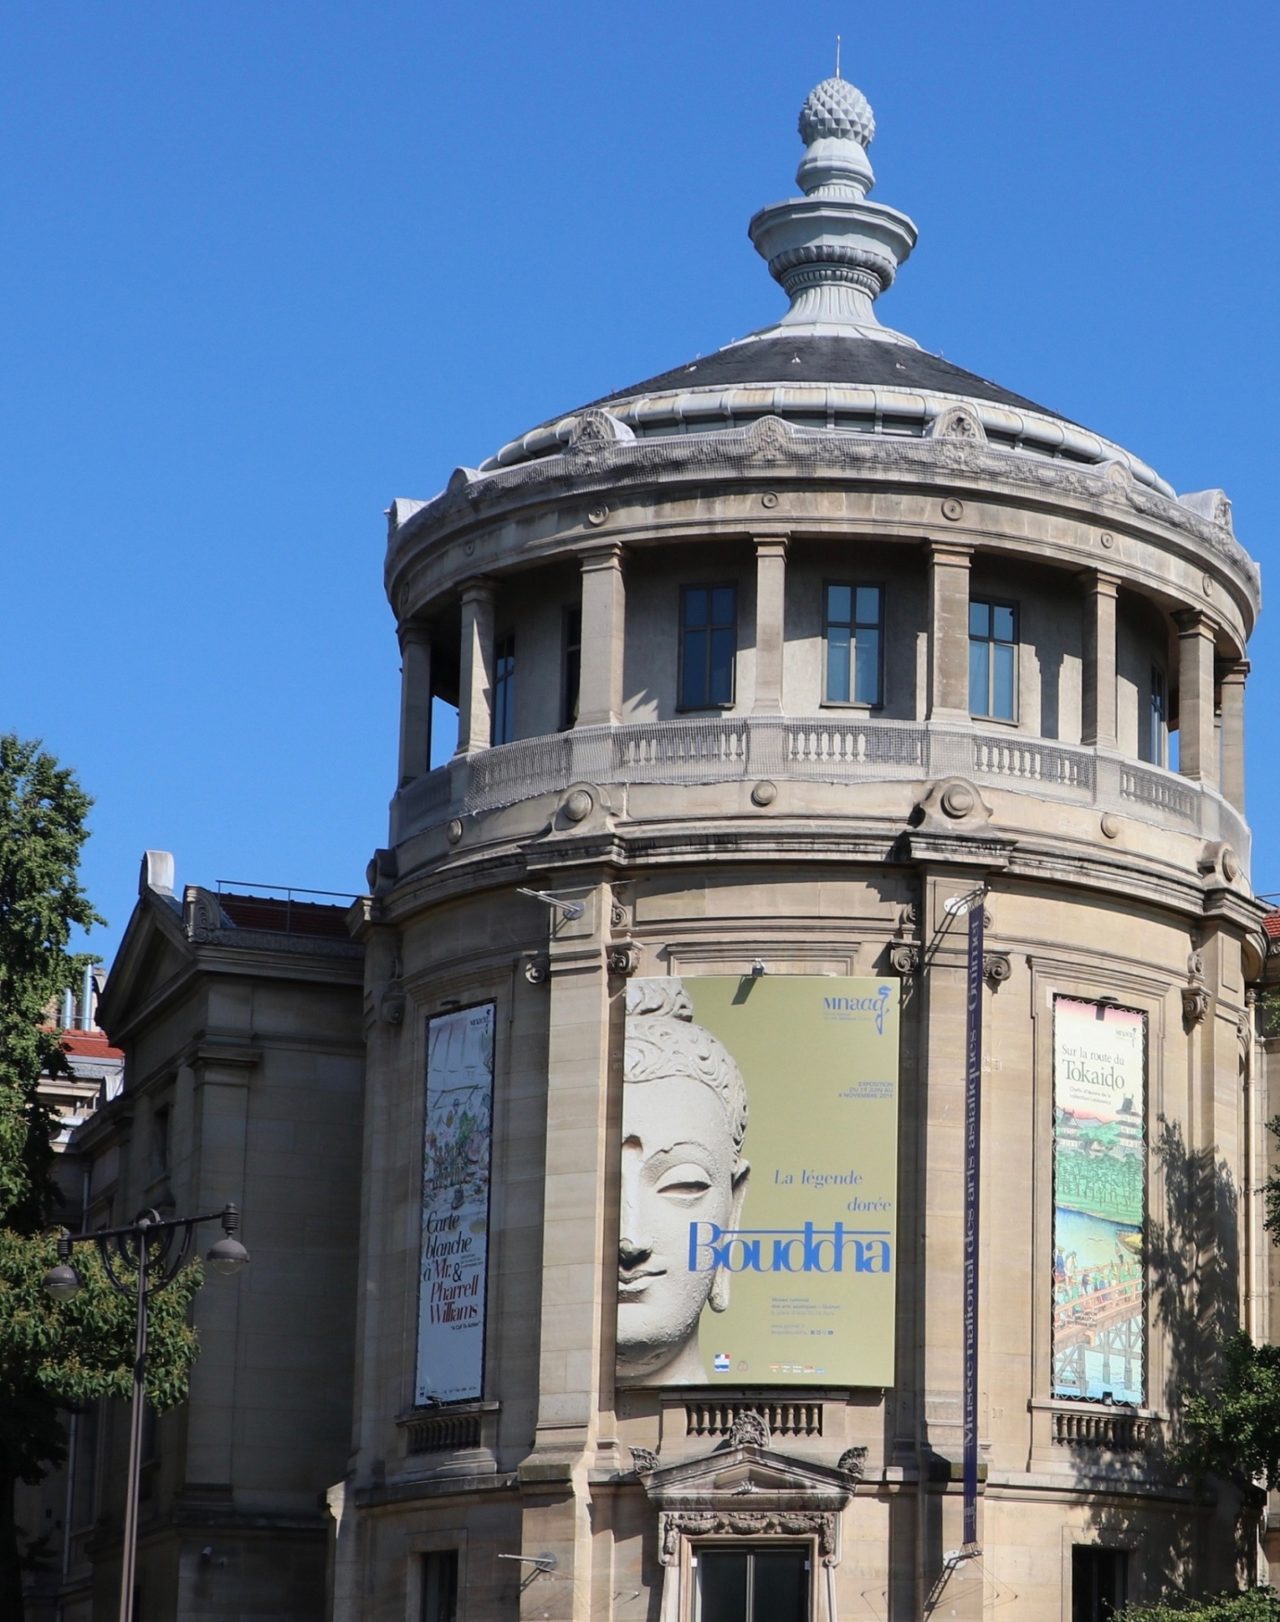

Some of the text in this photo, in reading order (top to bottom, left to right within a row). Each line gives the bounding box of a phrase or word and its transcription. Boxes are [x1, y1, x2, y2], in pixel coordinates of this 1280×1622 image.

[968, 920, 979, 1010] Guimet
[1062, 1044, 1125, 1066] Sur la route du
[1062, 1058, 1125, 1091] Tokaido
[966, 1030, 979, 1149] asiatiques
[774, 1168, 863, 1189] La légende
[965, 1156, 975, 1201] arts
[847, 1196, 892, 1212] dorée
[425, 1210, 460, 1234] Carte
[964, 1208, 975, 1253] des
[425, 1231, 473, 1259] blanche
[688, 1221, 891, 1273] Bouddha
[423, 1263, 431, 1282] à
[452, 1262, 462, 1283] &
[430, 1275, 479, 1303] Pharrell
[430, 1301, 478, 1325] Williams
[964, 1259, 975, 1355] national
